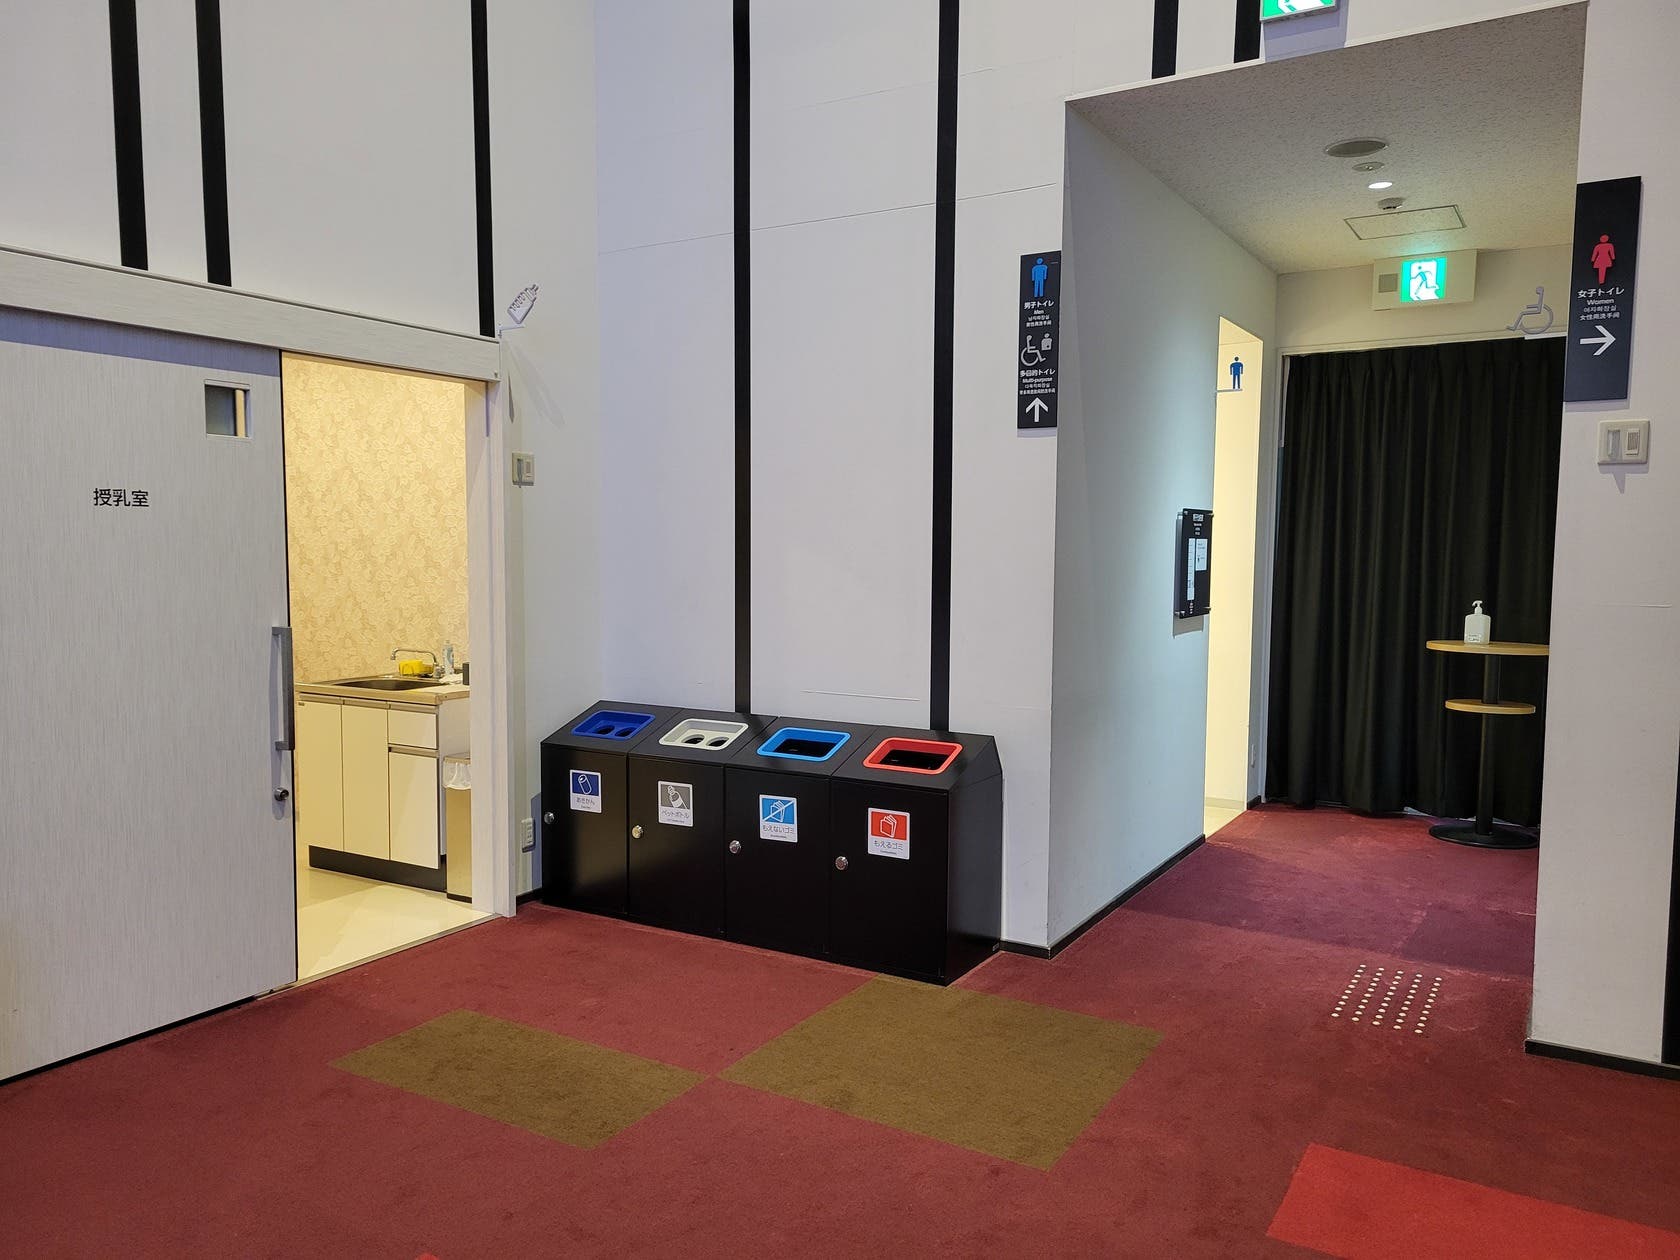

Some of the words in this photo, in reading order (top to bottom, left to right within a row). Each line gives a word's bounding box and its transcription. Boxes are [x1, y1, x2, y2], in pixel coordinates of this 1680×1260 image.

[1577, 287, 1625, 298] 女子トイレ
[1024, 300, 1055, 310] 男子トイレ
[1020, 368, 1056, 378] 多目的トイレ
[93, 488, 150, 507] 授乳室
[762, 825, 795, 834] もえないゴミ
[873, 840, 904, 851] もえるゴミ
